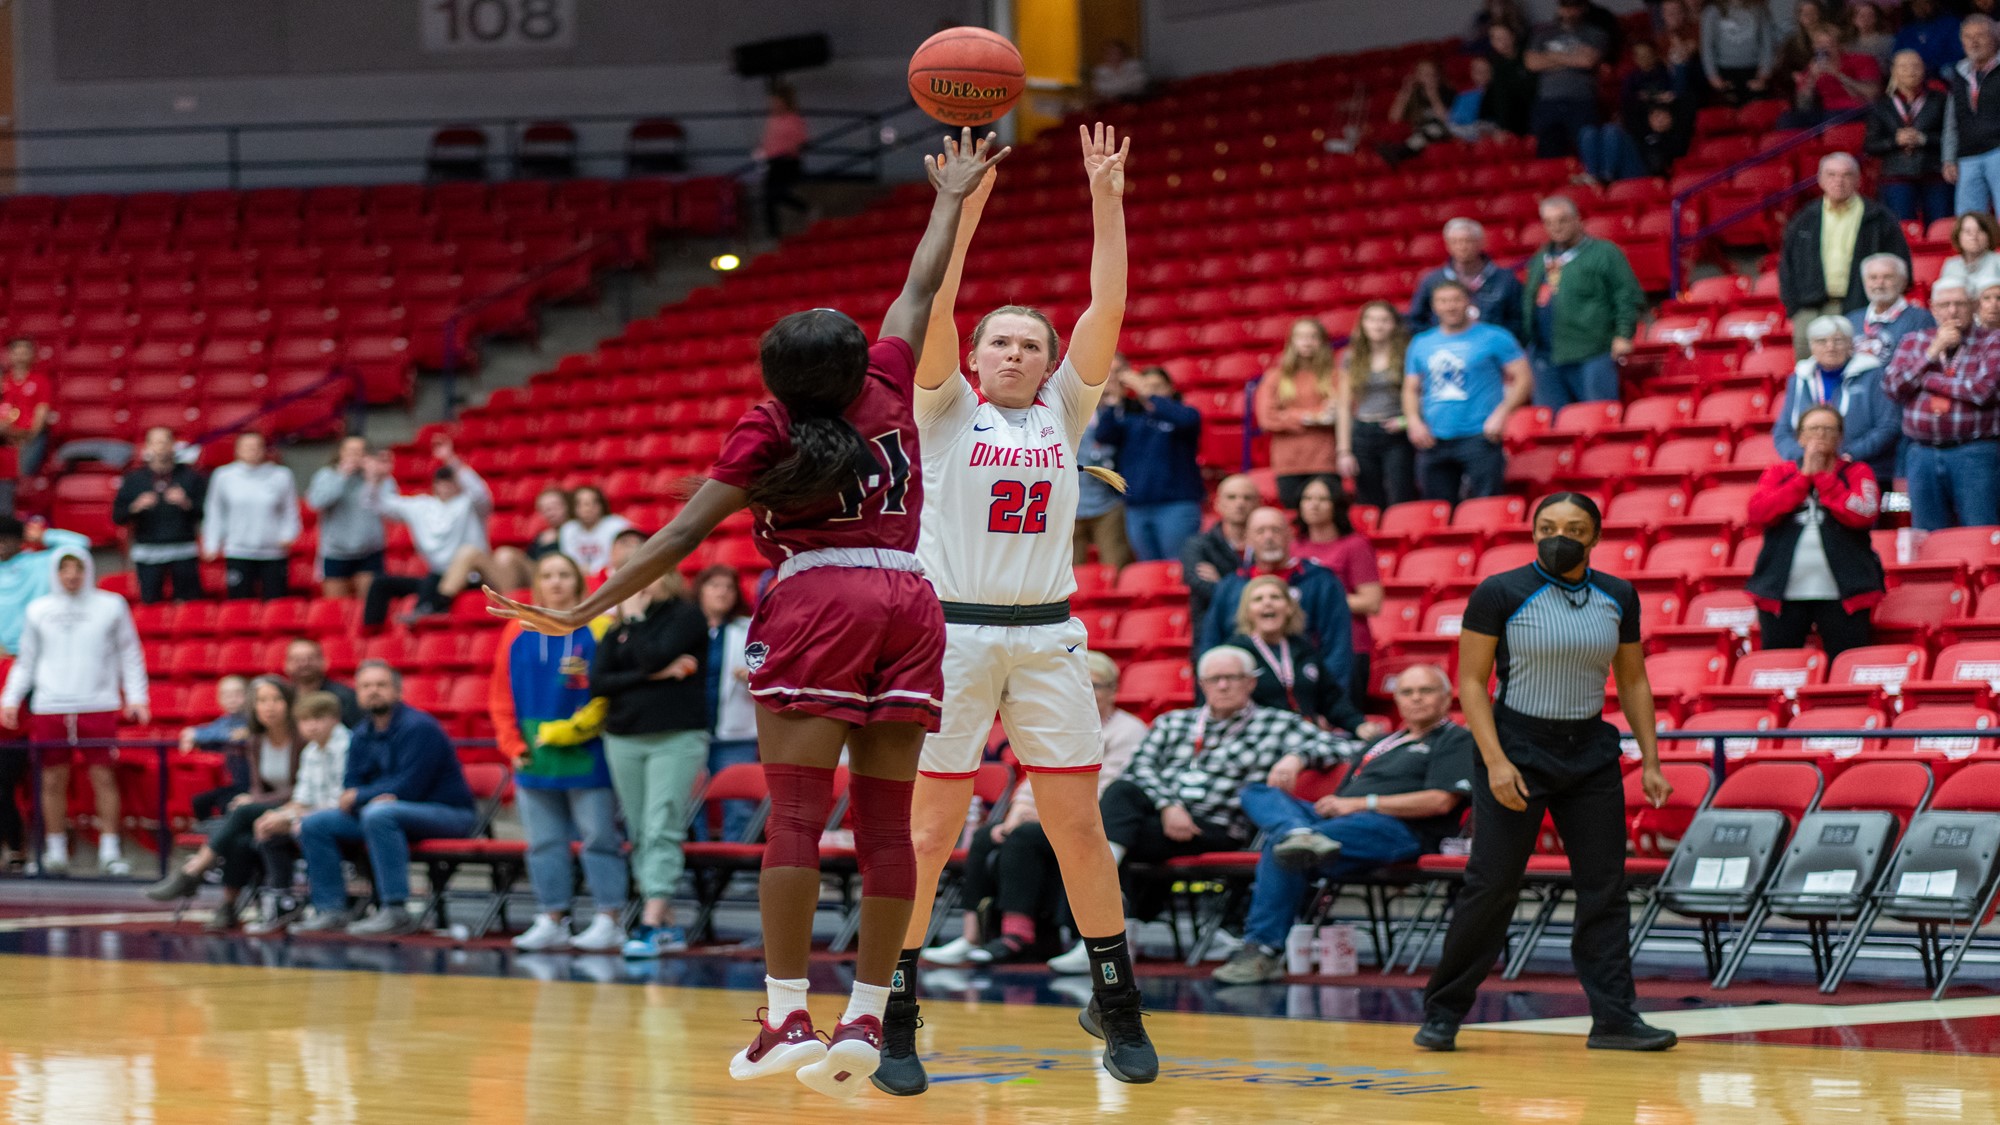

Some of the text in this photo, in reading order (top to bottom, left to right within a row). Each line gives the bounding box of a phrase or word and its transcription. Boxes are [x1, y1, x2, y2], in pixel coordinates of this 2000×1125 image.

[434, 0, 560, 42] 108
[929, 77, 1007, 99] Wilson
[969, 441, 1065, 469] DIXIE STATE
[987, 479, 1052, 534] 22
